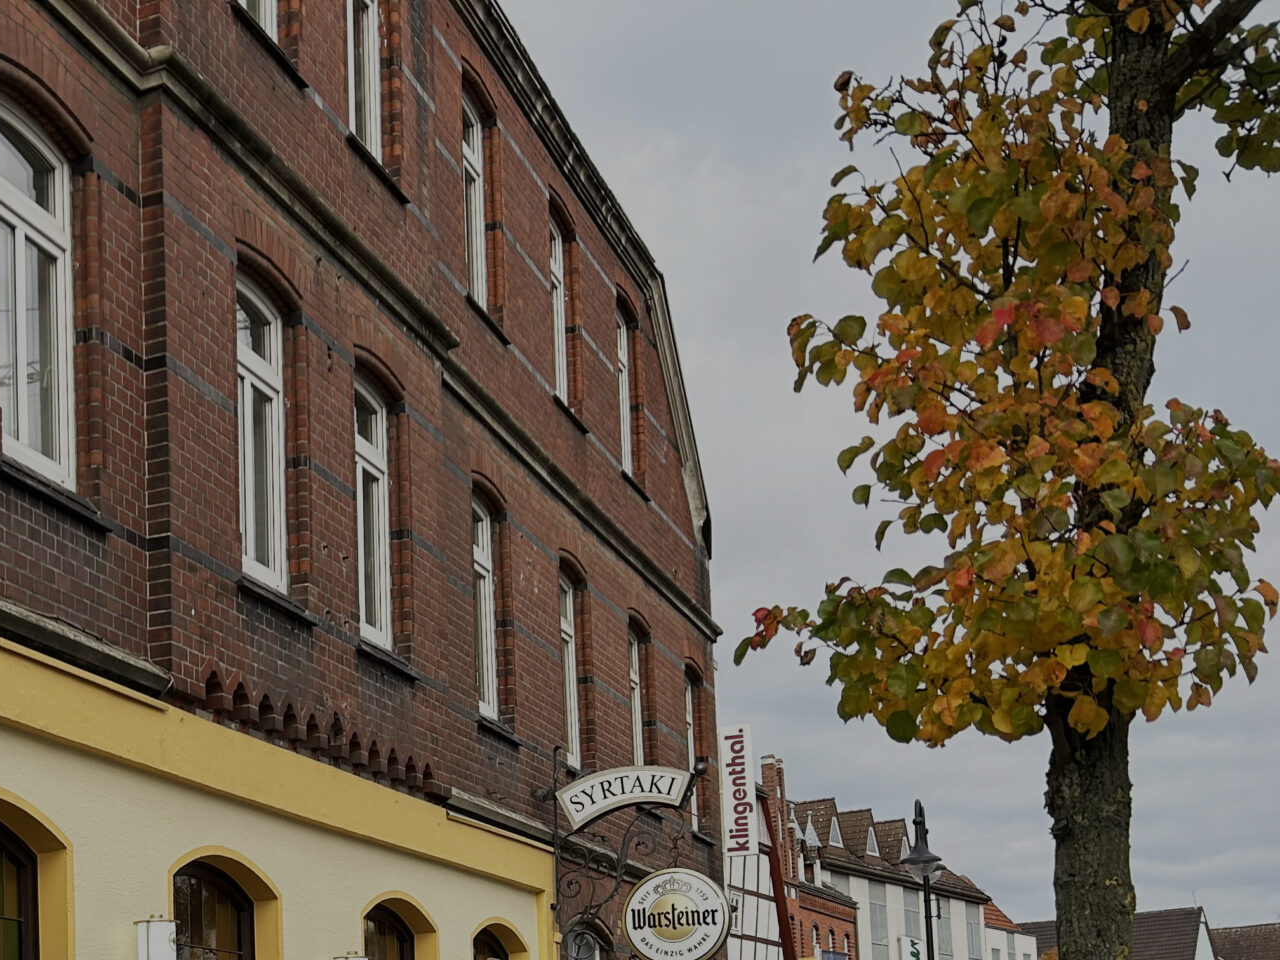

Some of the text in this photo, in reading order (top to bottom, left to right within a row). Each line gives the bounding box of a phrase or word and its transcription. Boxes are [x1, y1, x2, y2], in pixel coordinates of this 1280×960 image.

[569, 774, 677, 814] SYRTAKI
[724, 727, 754, 853] klingenthal.
[638, 887, 709, 905] SEIT 1753
[630, 902, 719, 931] Warsteiner
[640, 932, 711, 957] DAS EINZIG WAHRE
